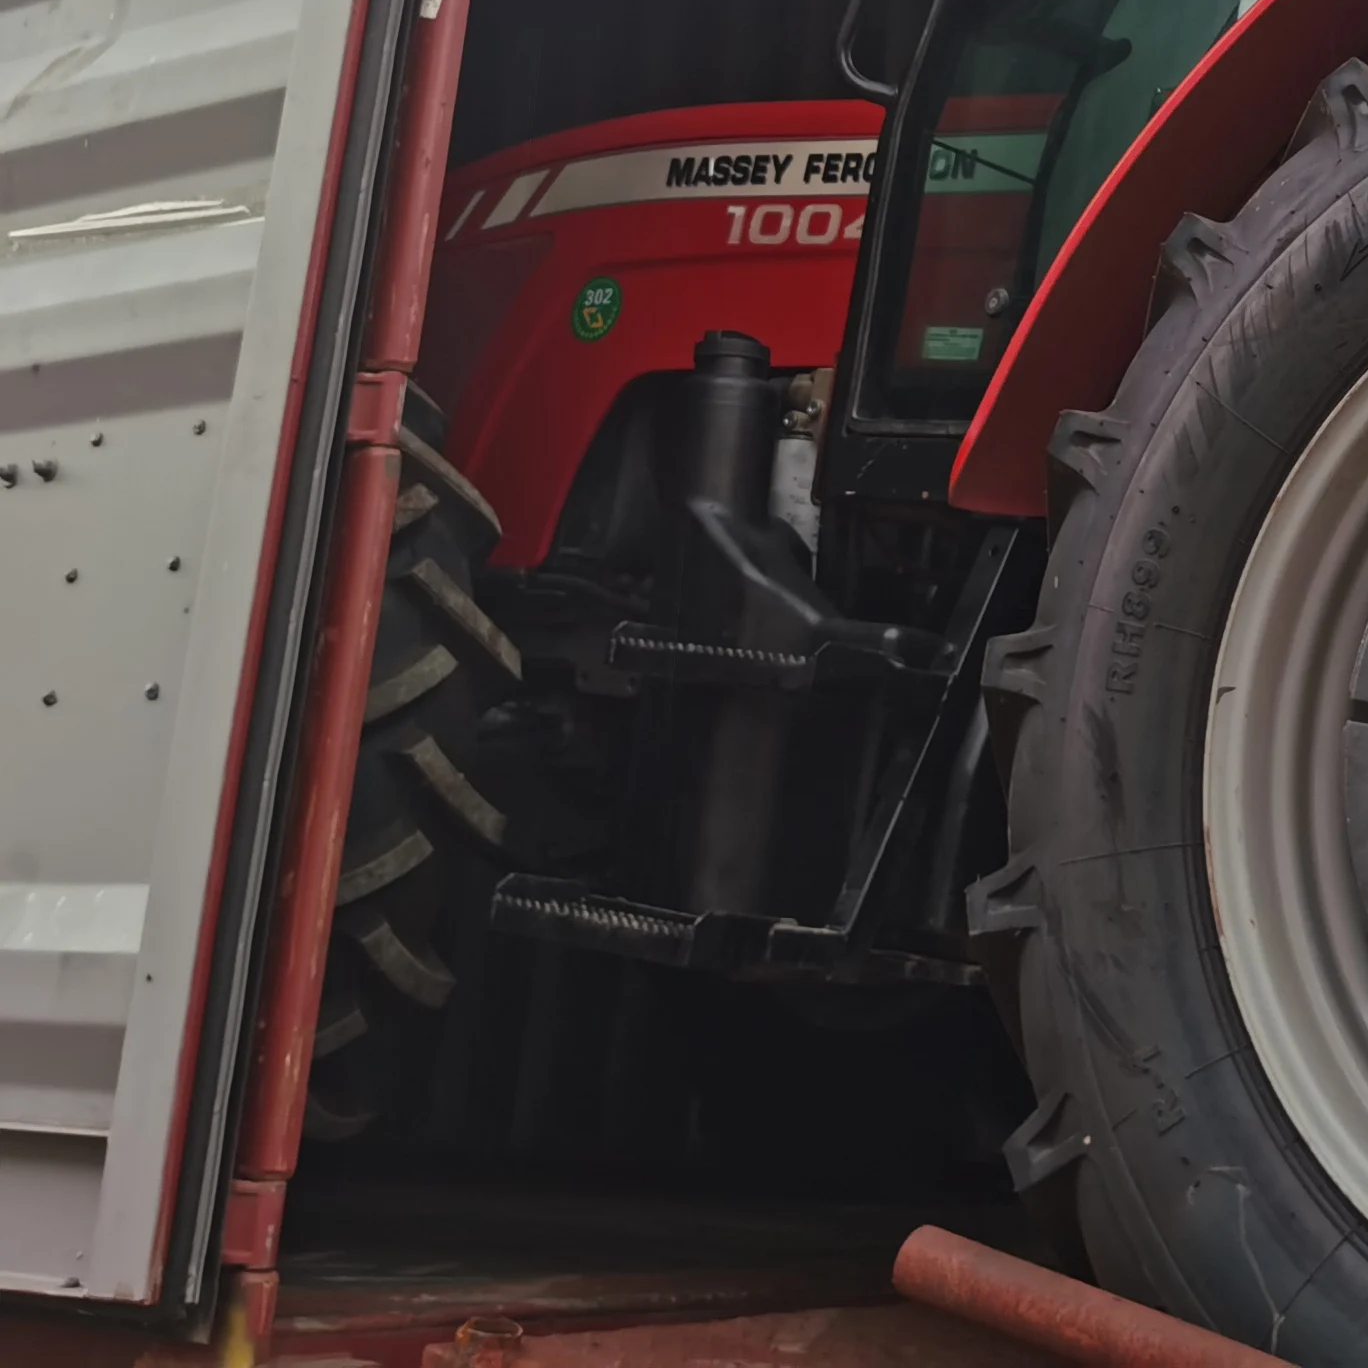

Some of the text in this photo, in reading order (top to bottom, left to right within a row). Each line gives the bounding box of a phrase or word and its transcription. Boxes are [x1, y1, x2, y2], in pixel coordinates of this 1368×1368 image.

[666, 153, 793, 188] MASSEY
[584, 287, 614, 306] 302
[1105, 528, 1172, 696] RH899
